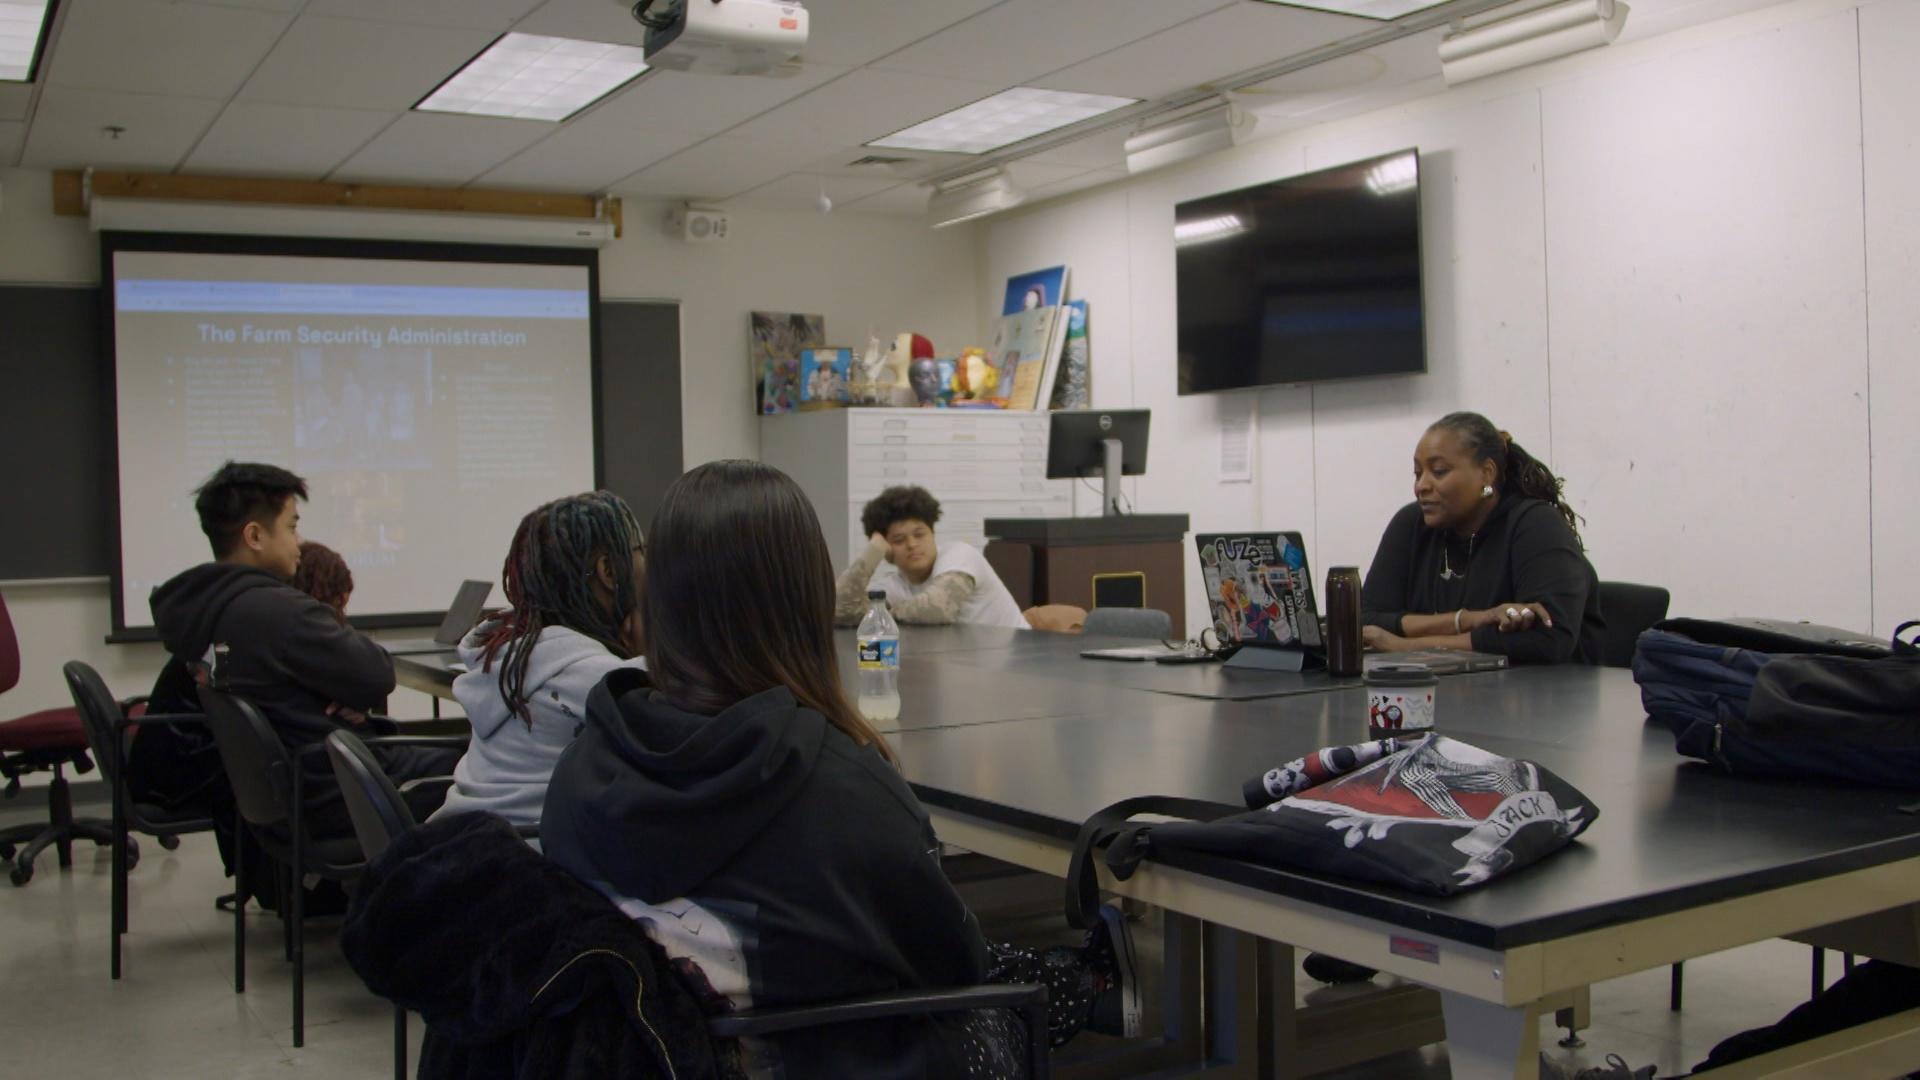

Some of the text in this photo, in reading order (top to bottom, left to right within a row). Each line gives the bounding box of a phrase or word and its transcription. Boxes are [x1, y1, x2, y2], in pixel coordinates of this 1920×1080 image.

[198, 323, 527, 349] The Farm Security Administration
[1488, 795, 1545, 838] JACK
